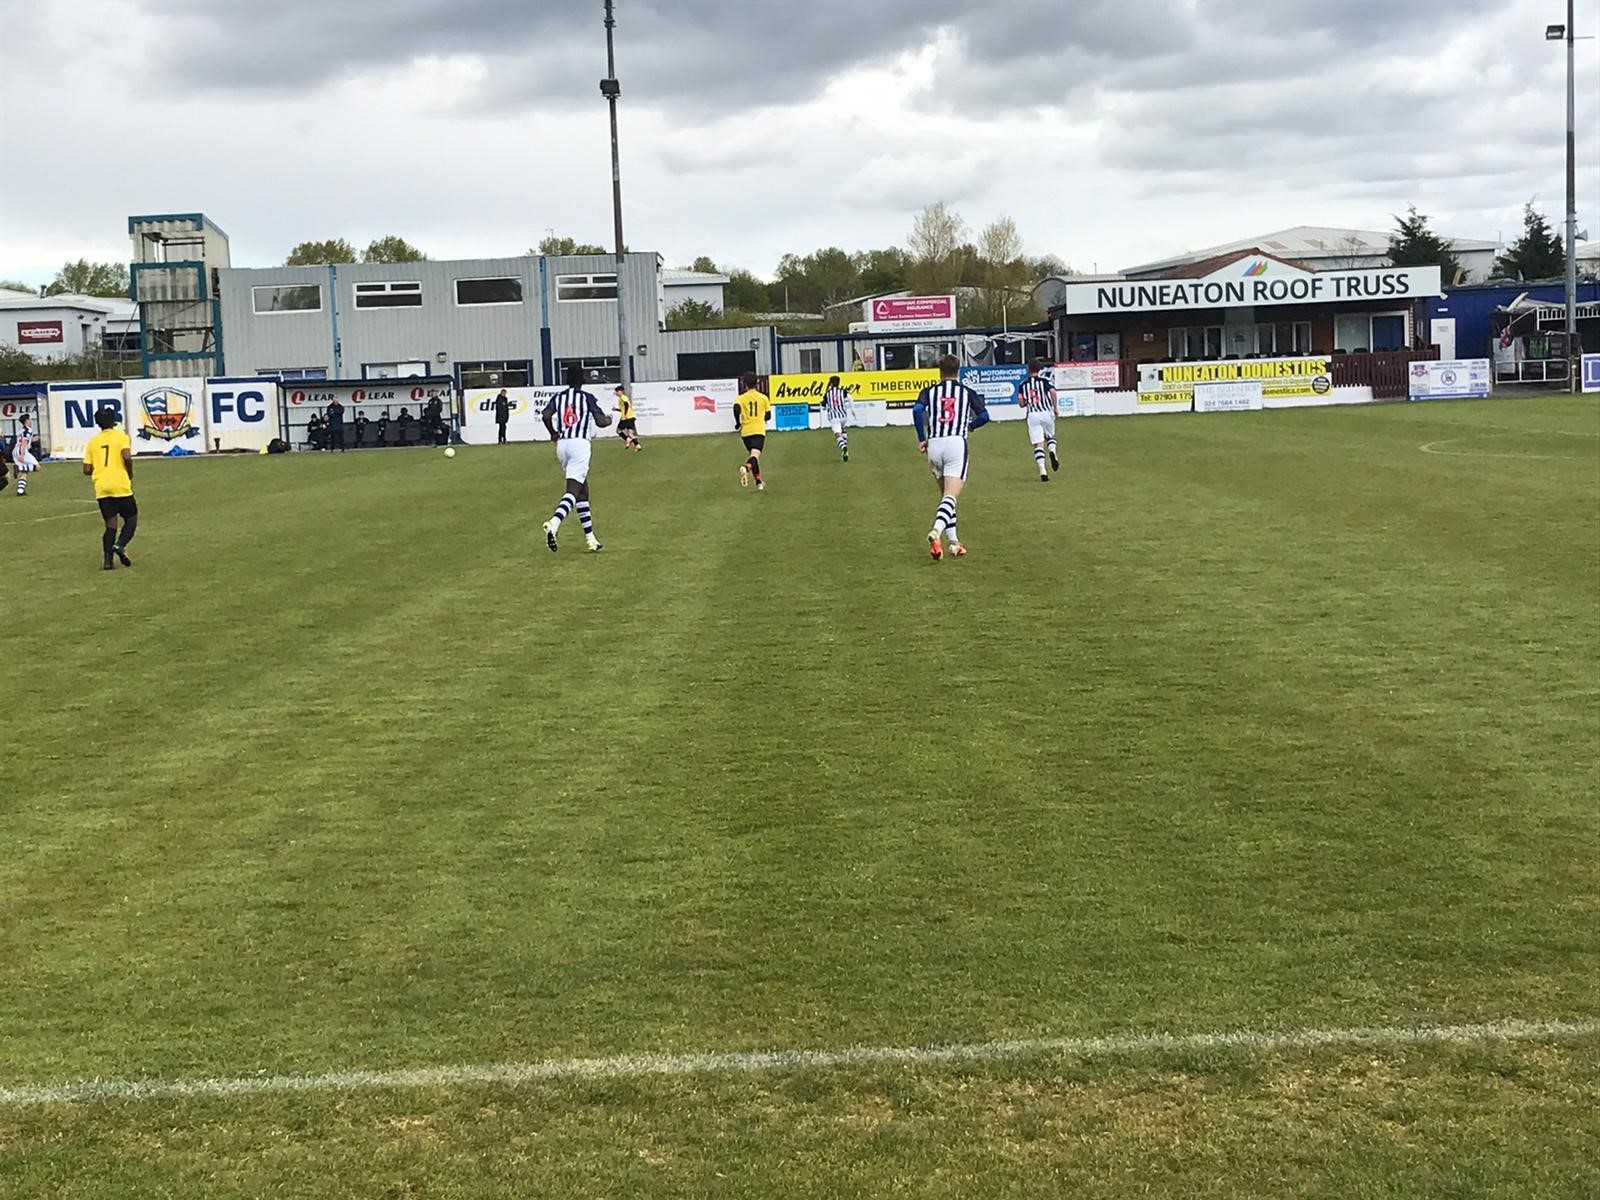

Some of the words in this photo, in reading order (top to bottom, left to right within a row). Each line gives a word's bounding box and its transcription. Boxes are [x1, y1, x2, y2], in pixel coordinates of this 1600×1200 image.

[1097, 281, 1245, 308] NUNEATON
[1253, 278, 1323, 302] ROOF
[1331, 273, 1409, 298] TRUSS
[980, 368, 1027, 377] MOTORHOMES
[1162, 363, 1239, 382] NUNEATON
[1240, 359, 1327, 380] DOMESTICS
[776, 380, 823, 397] Arnold
[869, 379, 938, 392] TIMBERWOR
[308, 393, 335, 402] LEAR
[368, 391, 395, 400] LEAR
[19, 405, 38, 414] LEA
[211, 391, 265, 424] FC
[563, 403, 579, 427] 6
[749, 400, 759, 417] 11
[938, 396, 957, 422] 3
[100, 445, 110, 467] 7
